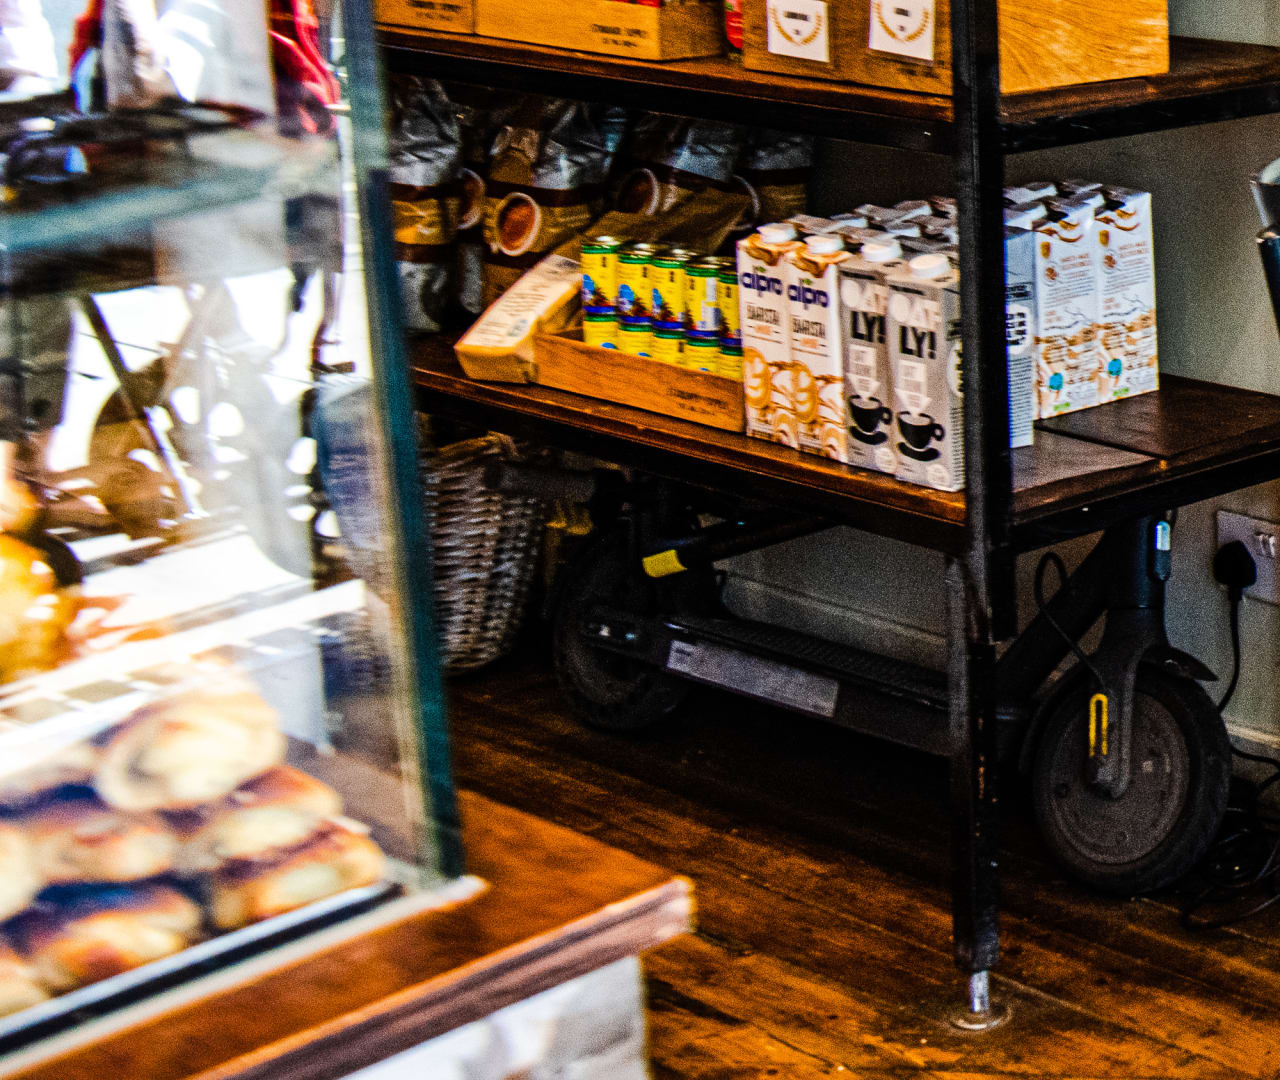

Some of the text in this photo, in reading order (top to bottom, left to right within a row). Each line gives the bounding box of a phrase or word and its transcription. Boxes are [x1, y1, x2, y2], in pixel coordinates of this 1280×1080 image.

[741, 265, 783, 298] alpro
[787, 277, 829, 311] alpro
[850, 310, 887, 344] LY!
[898, 324, 937, 360] LY!
